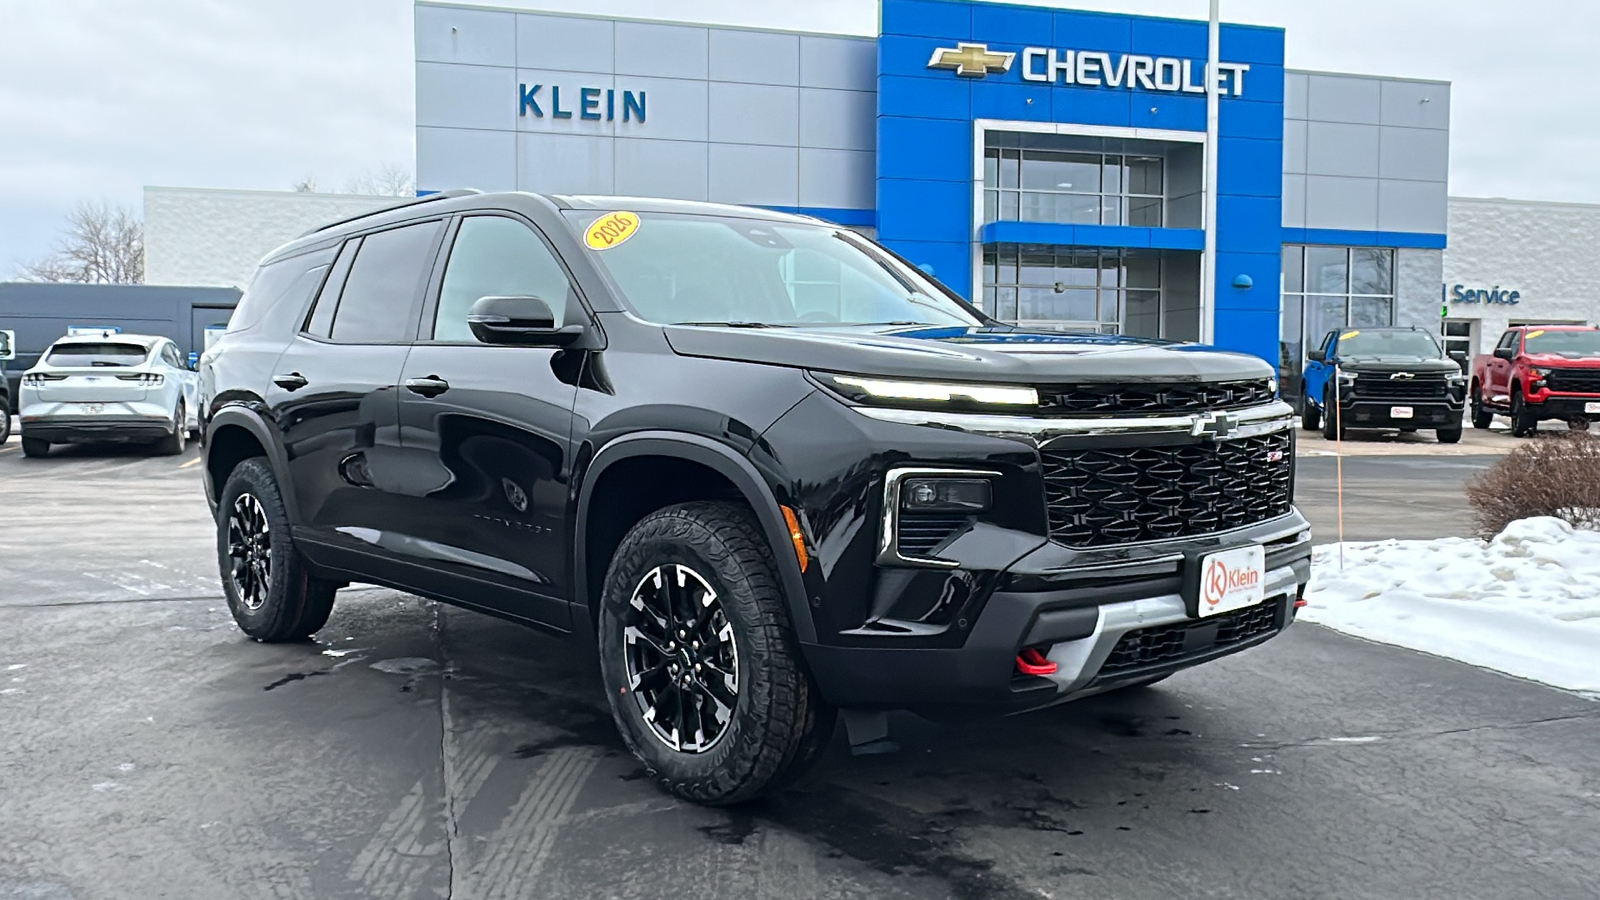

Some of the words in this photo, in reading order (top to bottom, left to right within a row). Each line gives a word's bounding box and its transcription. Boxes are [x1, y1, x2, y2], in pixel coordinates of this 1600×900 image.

[1022, 46, 1250, 97] CHEVROLET
[519, 83, 646, 124] KLEIN
[593, 214, 632, 245] 2026
[1453, 283, 1521, 306] Service
[1228, 566, 1258, 589] Klein
